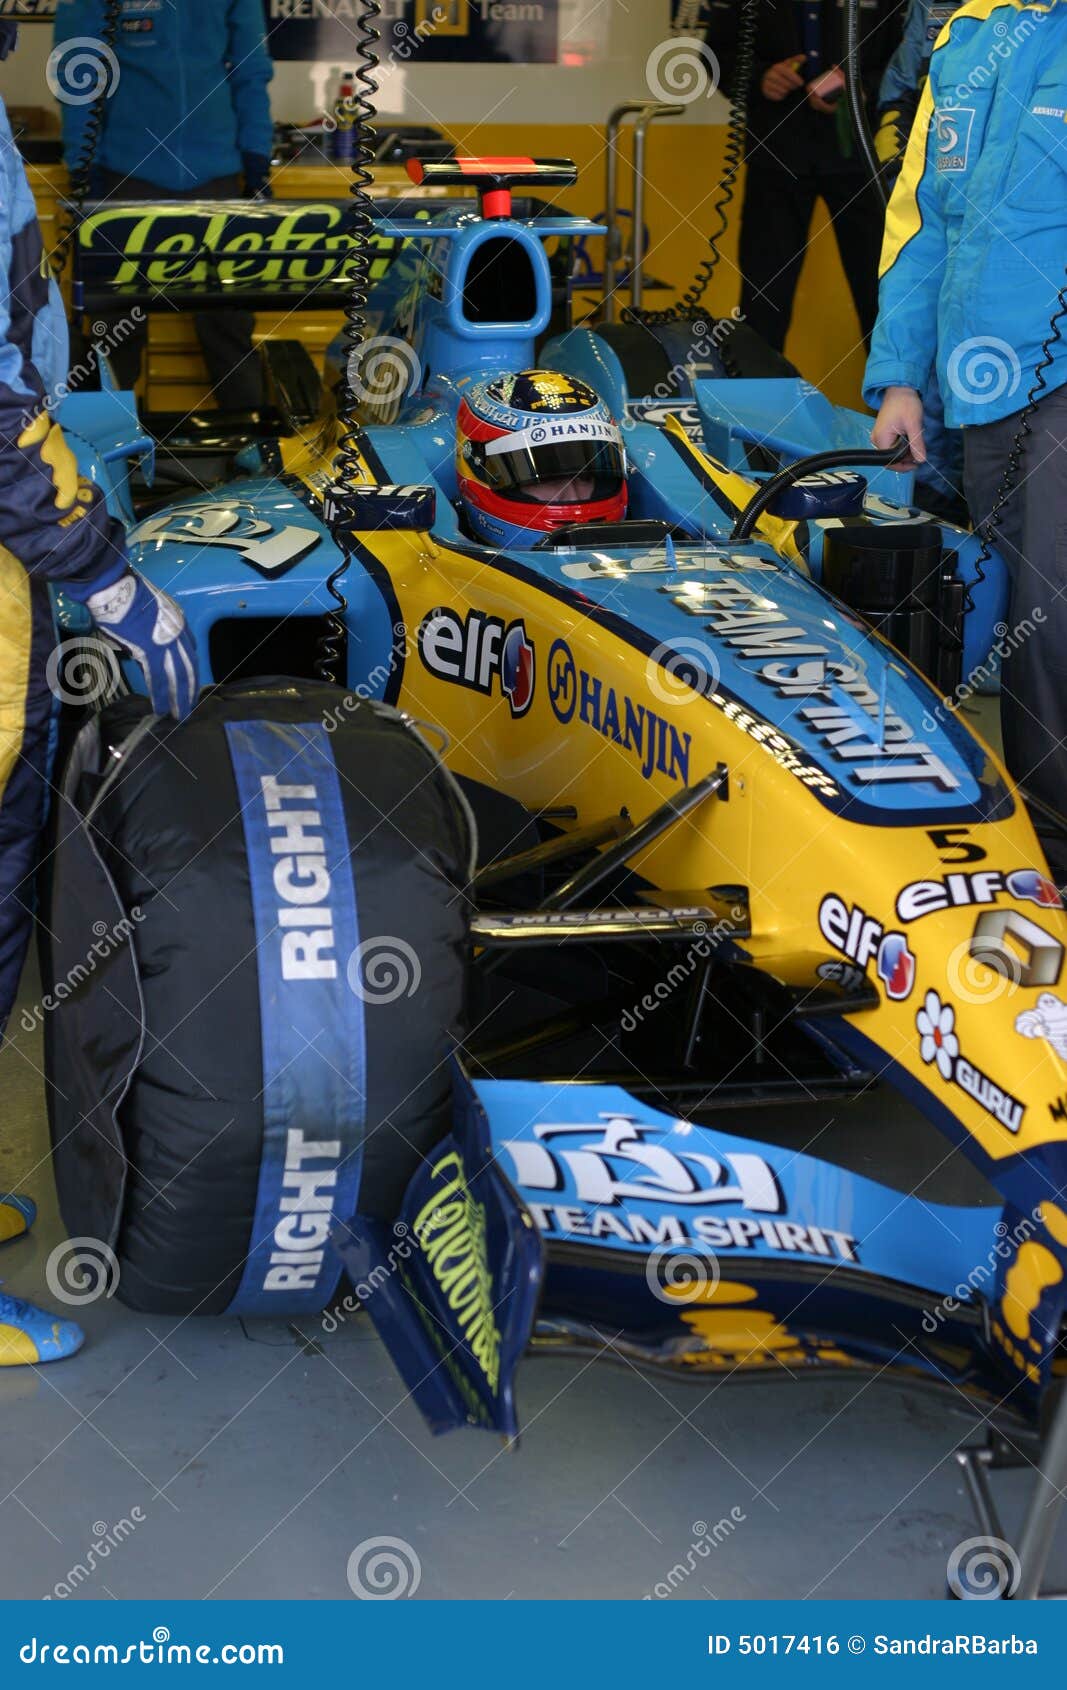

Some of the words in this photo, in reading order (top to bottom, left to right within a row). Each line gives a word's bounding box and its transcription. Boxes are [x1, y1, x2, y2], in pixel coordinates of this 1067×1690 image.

[551, 423, 612, 437] HANJIN
[421, 613, 503, 690] elf
[661, 577, 830, 657] TEAM
[762, 661, 961, 788] SPIRIT
[579, 669, 692, 789] HANJIN
[260, 774, 338, 981] RIGHT
[926, 828, 988, 864] 5
[512, 906, 699, 925] MICHELIN
[818, 895, 885, 969] elf
[896, 870, 1003, 922] elf
[954, 1057, 1025, 1134] GURU
[262, 1127, 342, 1291] RIGHT
[528, 1202, 686, 1244] TEAM
[691, 1215, 857, 1261] SPIRIT
